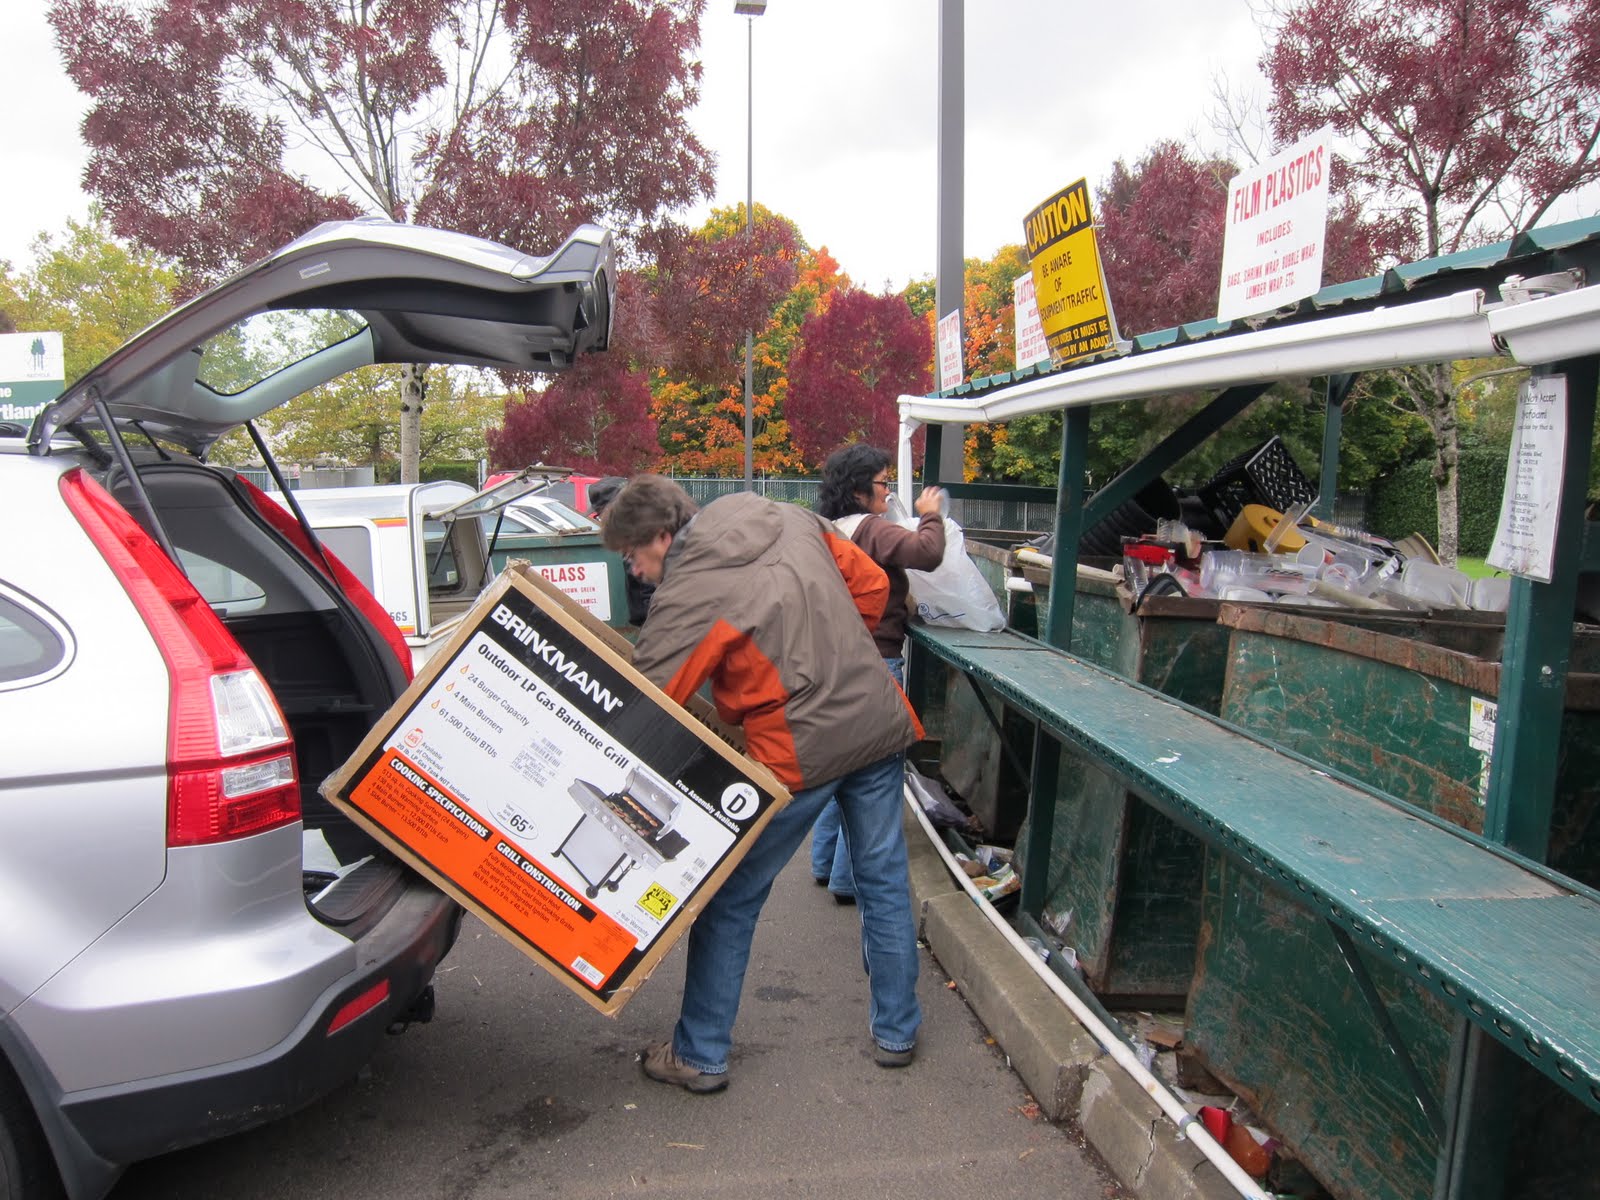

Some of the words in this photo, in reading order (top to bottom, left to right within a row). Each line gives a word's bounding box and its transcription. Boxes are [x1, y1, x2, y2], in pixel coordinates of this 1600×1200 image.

[1233, 178, 1262, 224] FILM
[1265, 145, 1324, 211] PLASTICS
[1025, 186, 1088, 254] CAUTION
[1256, 220, 1294, 247] INCLUDES:
[1042, 264, 1050, 278] BE
[1050, 251, 1073, 273] AWARE
[1054, 277, 1062, 293] OF
[1040, 285, 1098, 322] EQUIPMENT/TRAFFIC
[1070, 343, 1077, 355] BY
[1080, 340, 1089, 353] AN
[1090, 334, 1110, 350] ADULT
[1080, 322, 1098, 337] MUST
[1098, 319, 1109, 332] BE
[541, 566, 586, 582] GLASS
[489, 602, 620, 713] BRINKMANN
[452, 689, 461, 699] 4
[457, 694, 479, 713] Main
[475, 708, 505, 734] Burners
[466, 672, 479, 684] 24
[474, 679, 502, 704] Burger
[498, 698, 531, 728] Capacity
[476, 642, 523, 683] Outdoor
[519, 677, 538, 695] LP
[533, 689, 558, 712] Gas
[554, 706, 606, 750] Barbecue
[601, 744, 630, 769] Grill
[436, 707, 464, 731] 61,500
[460, 725, 481, 744] Total
[477, 739, 499, 759] BTUs
[369, 789, 382, 801] Side
[379, 797, 398, 814] Burner
[389, 757, 429, 791] COOKING
[424, 785, 489, 838] SPECIFICATIONS
[409, 753, 418, 762] LP
[416, 758, 428, 769] Gas
[425, 766, 440, 778] Tank
[437, 775, 450, 787] NOT
[448, 783, 471, 803] Included
[374, 783, 389, 796] Main
[386, 792, 407, 810] Burners
[423, 822, 438, 835] BTUs
[435, 831, 450, 844] Each
[398, 792, 422, 813] Warming
[419, 808, 439, 826] Surface
[403, 786, 425, 805] Cooking
[422, 801, 443, 818] Surface
[447, 820, 470, 840] Burgers)
[674, 778, 690, 793] Free
[686, 788, 716, 815] Assembly
[713, 809, 741, 834] Available
[725, 792, 749, 817] D
[477, 864, 491, 876] Push
[488, 873, 500, 883] and
[497, 880, 511, 892] Turn
[507, 888, 533, 910] Integrated
[486, 851, 501, 864] Fully
[498, 860, 518, 877] Welded
[514, 873, 537, 892] Stainless
[535, 889, 549, 902] Steel
[495, 840, 523, 865] GRILL
[519, 859, 582, 911] CONSTRUCTION
[520, 887, 533, 899] Cast
[539, 903, 561, 922] Cooking
[558, 917, 575, 932] Grates
